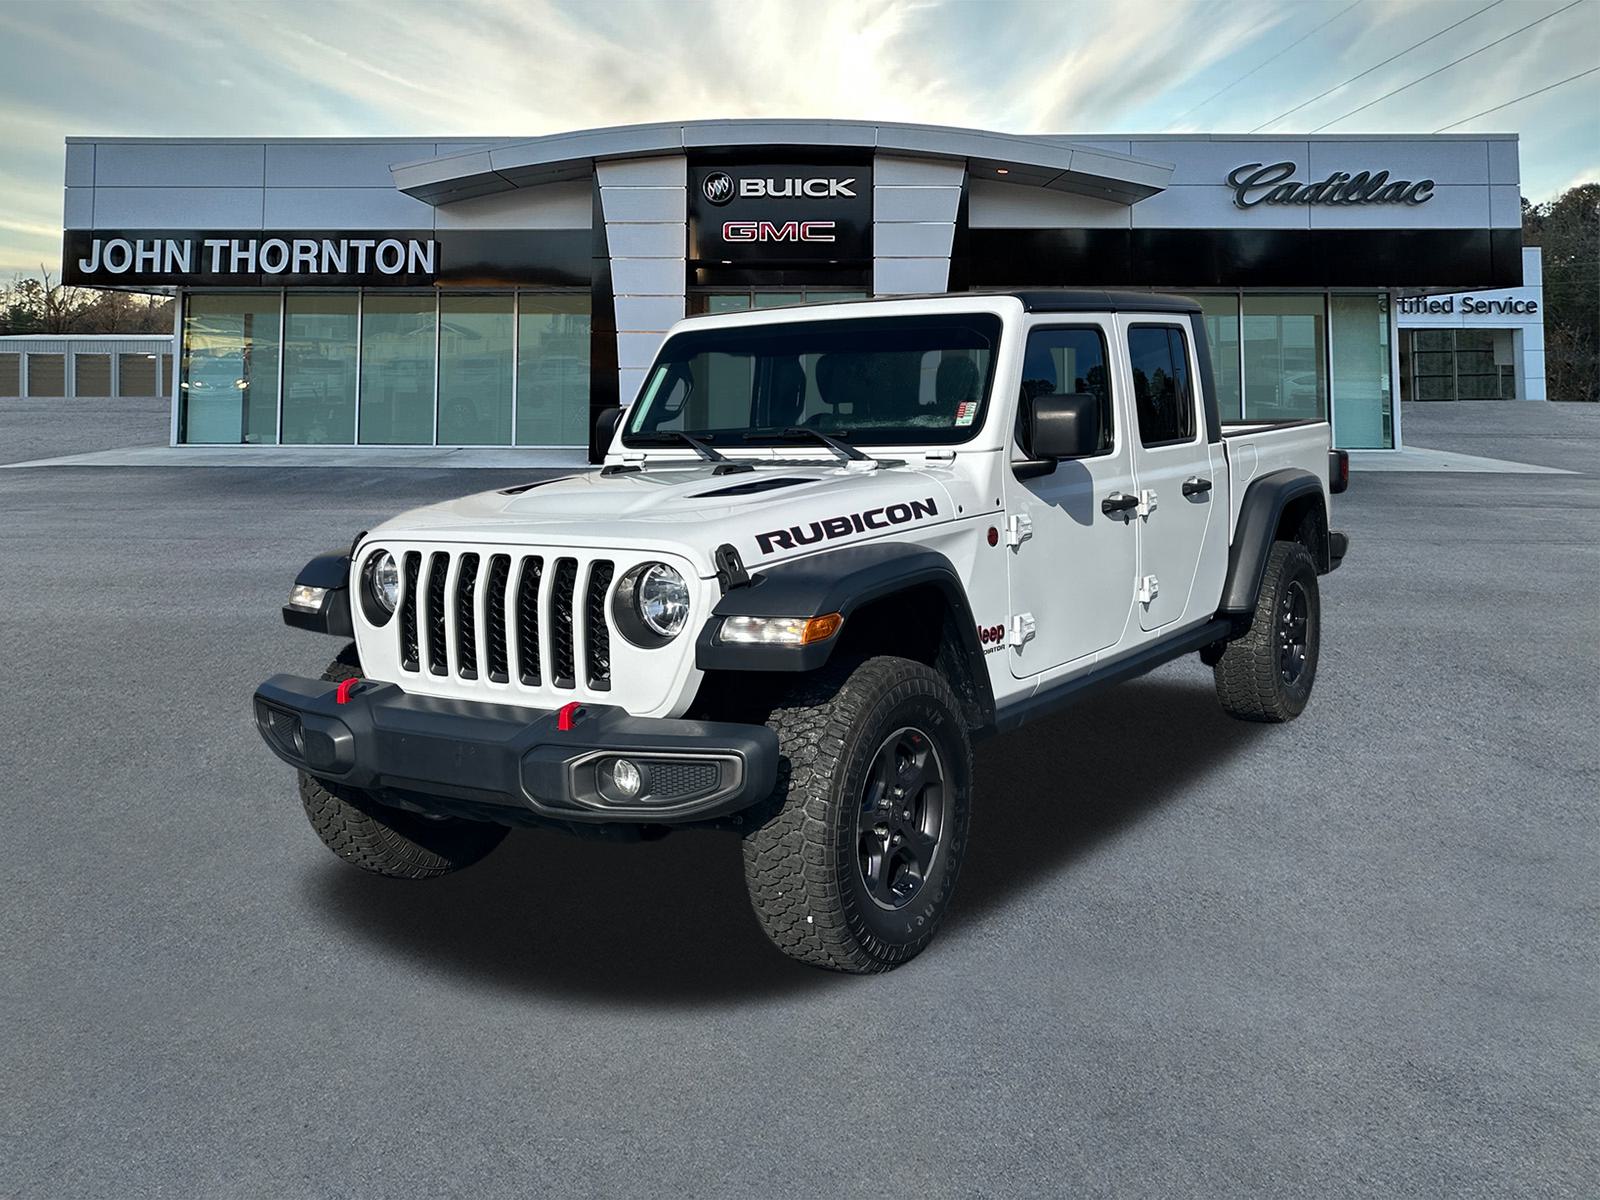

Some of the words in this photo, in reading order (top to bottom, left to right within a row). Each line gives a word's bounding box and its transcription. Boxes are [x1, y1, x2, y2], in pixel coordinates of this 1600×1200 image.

[739, 178, 857, 198] BUICK
[1226, 161, 1436, 209] Cadillac
[722, 221, 836, 242] GMC
[78, 238, 191, 274] JOHN
[204, 238, 435, 275] THORNTON
[1398, 296, 1454, 314] tified
[1461, 296, 1538, 314] Service
[755, 497, 939, 555] RUBICON
